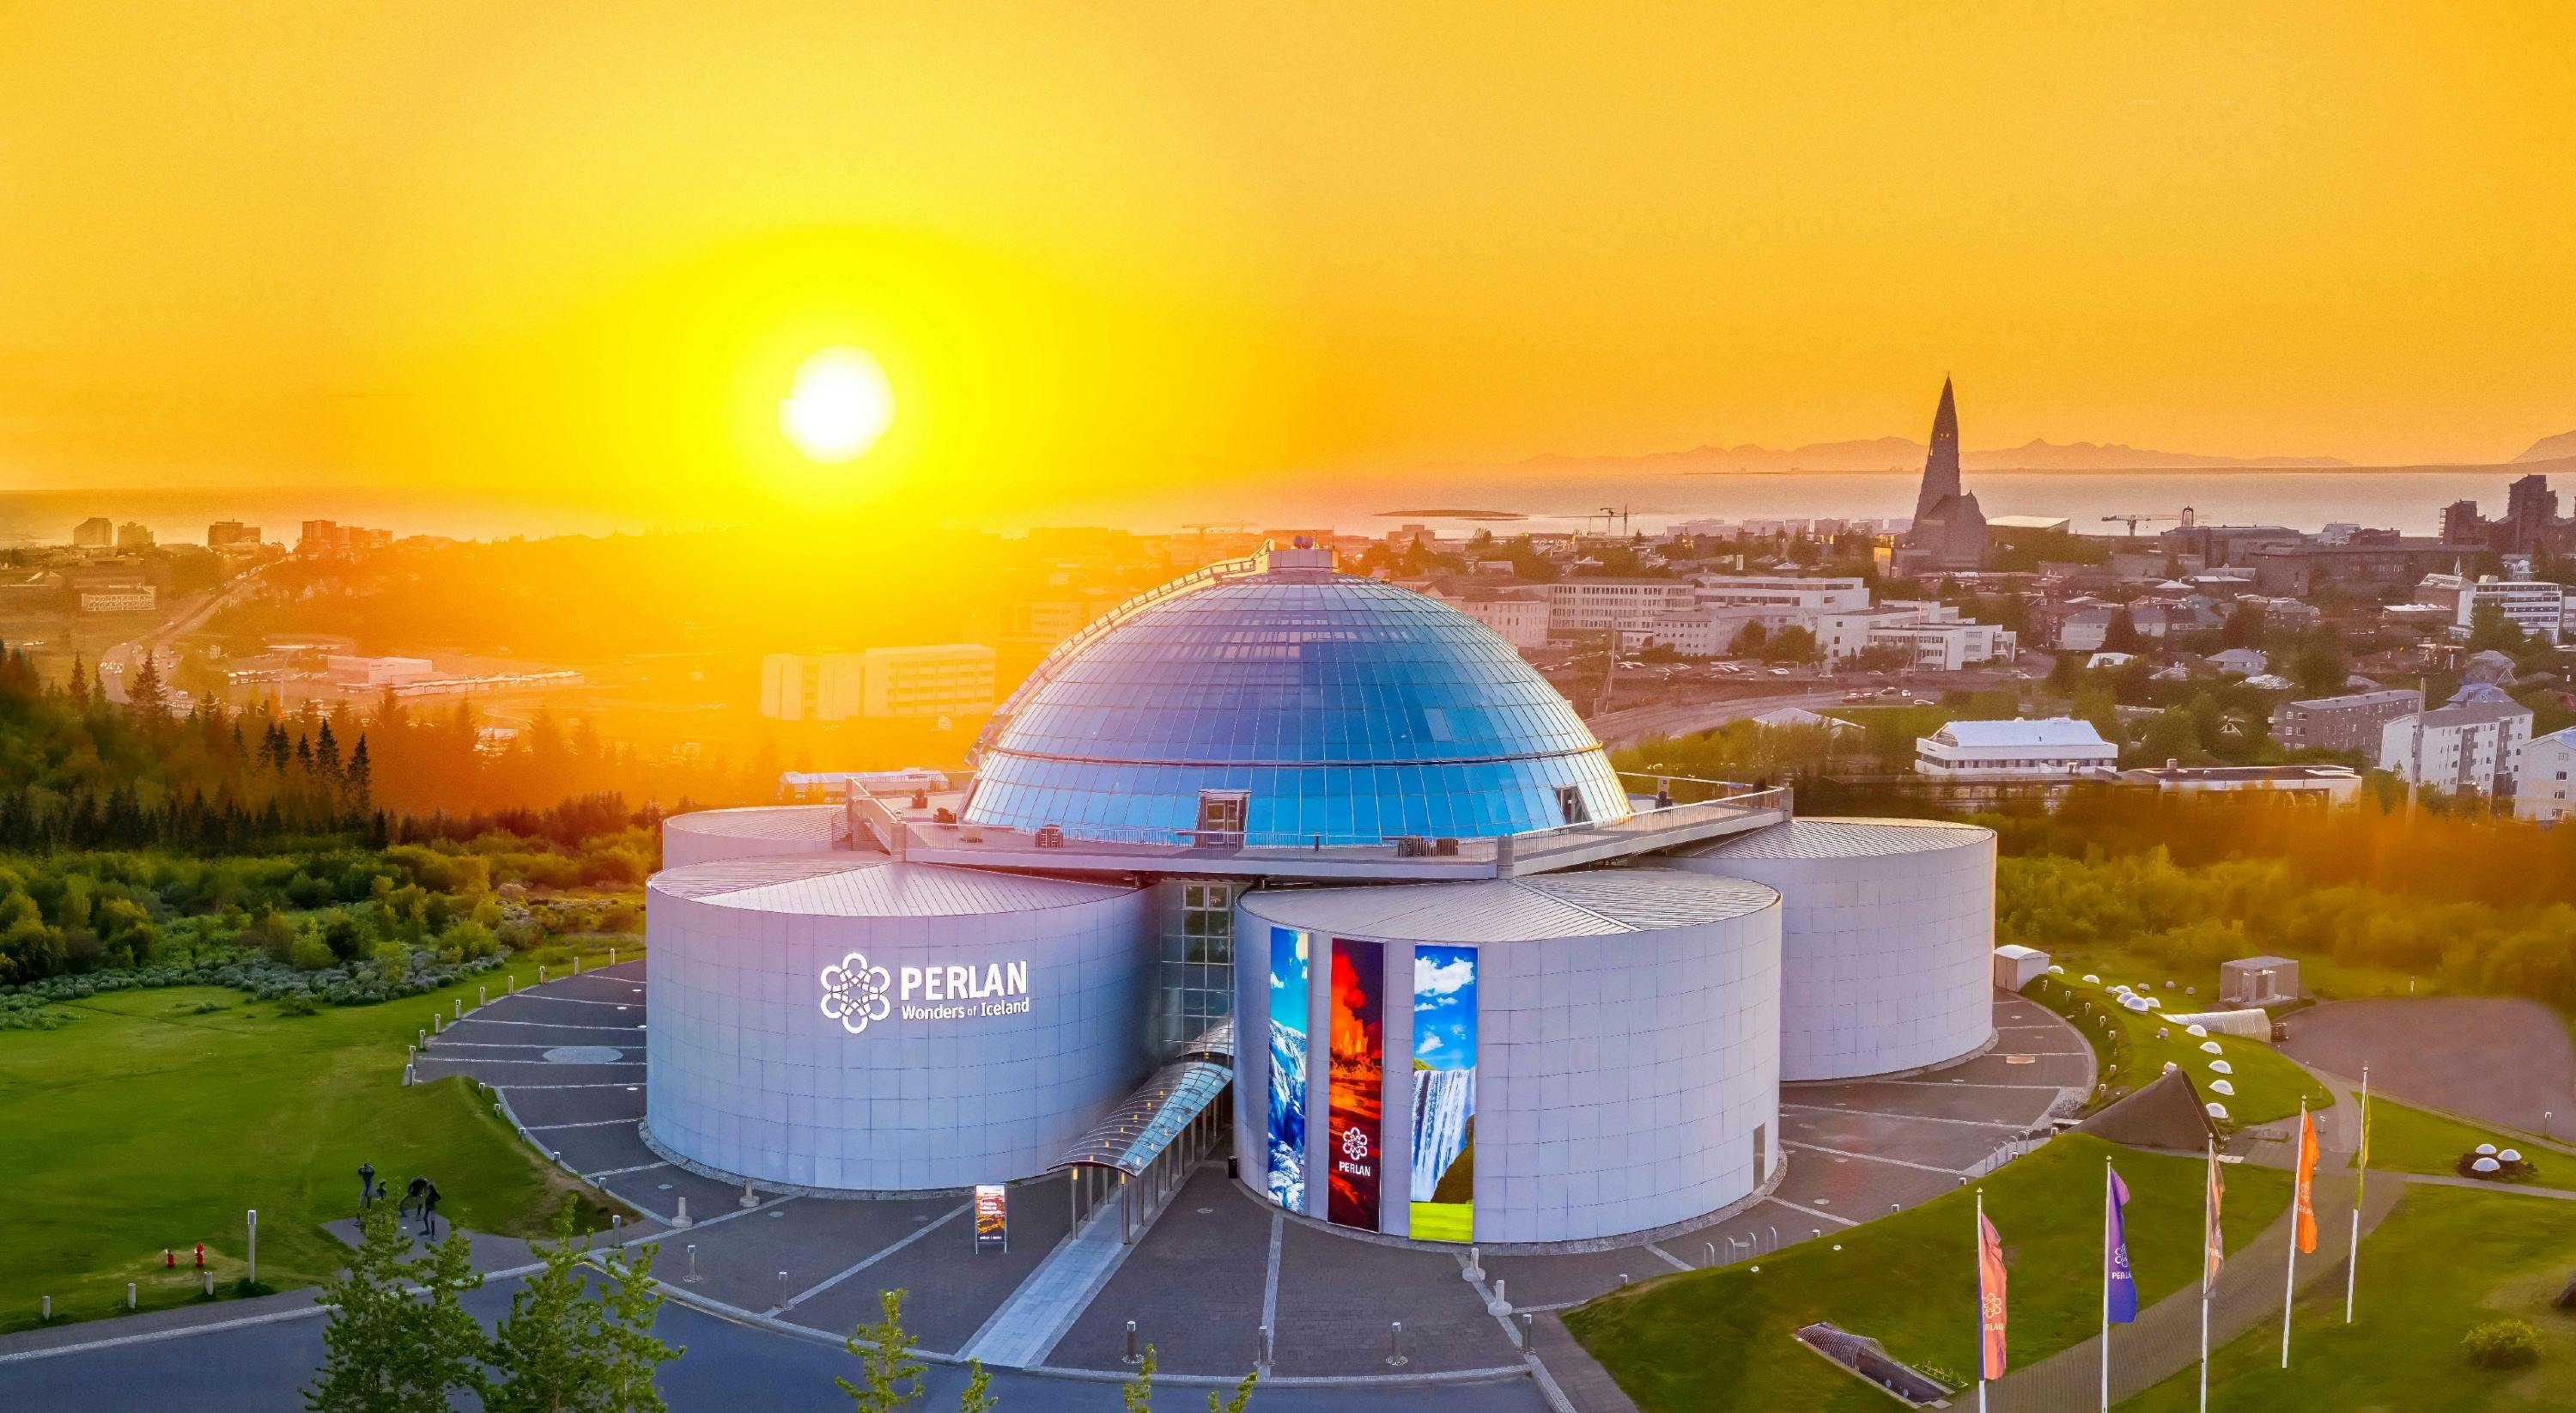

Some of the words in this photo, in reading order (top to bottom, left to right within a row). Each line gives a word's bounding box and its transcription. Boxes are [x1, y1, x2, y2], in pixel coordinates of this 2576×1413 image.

[901, 960, 1028, 1001] PERLAN
[902, 1004, 965, 1020] Wonders
[967, 1005, 977, 1017] of
[981, 997, 1030, 1017] Iceland
[1339, 1160, 1371, 1177] PERLAN
[1984, 1323, 2004, 1331] RLAN
